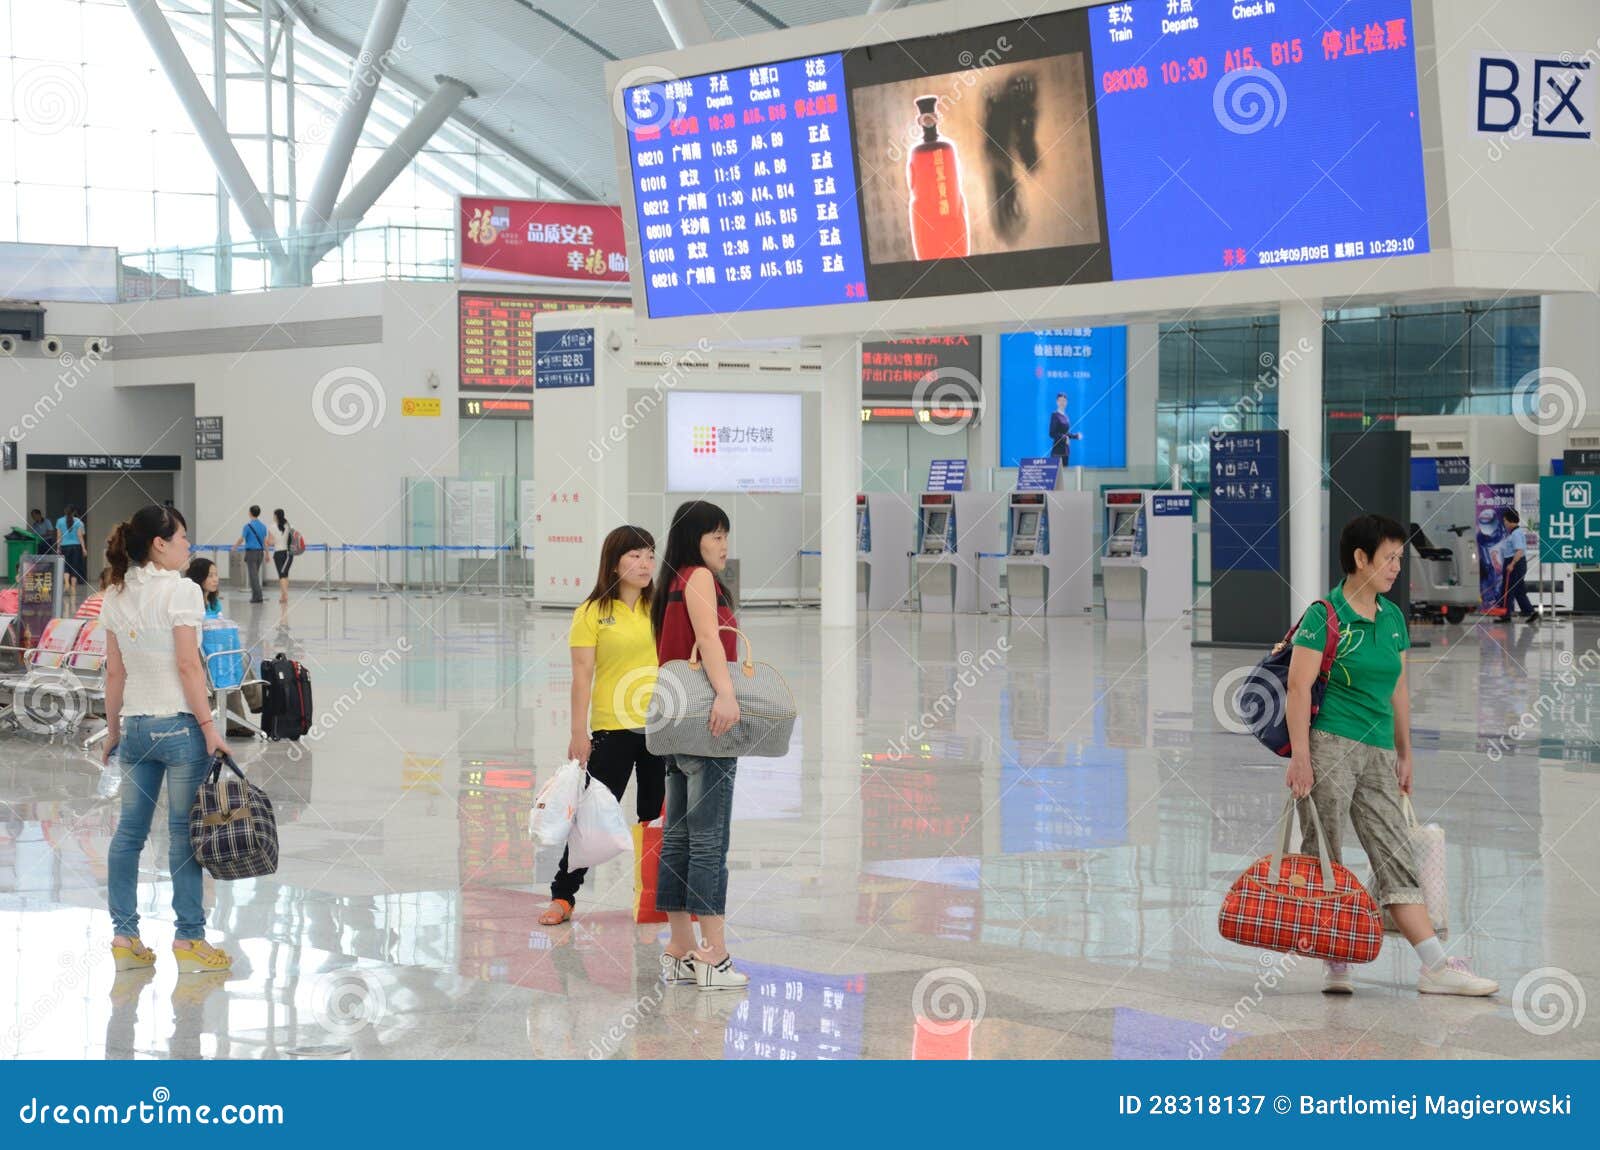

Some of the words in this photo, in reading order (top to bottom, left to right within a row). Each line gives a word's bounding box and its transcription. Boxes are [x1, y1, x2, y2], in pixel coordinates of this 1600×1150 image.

[1108, 4, 1134, 25] 车次
[1232, 5, 1265, 20] Check
[1265, 1, 1276, 14] In
[1109, 28, 1133, 43] Train
[1162, 16, 1199, 35] Departs
[1161, 56, 1208, 85] 10:30
[1322, 18, 1407, 61] 停止检票
[709, 74, 730, 93] 开点
[805, 58, 826, 77] 状态
[1478, 57, 1591, 139] B区
[711, 139, 738, 157] 10:55
[807, 122, 831, 143] 正点
[714, 164, 741, 183] 11:15
[811, 149, 834, 170] 正点
[717, 190, 744, 207] 11:30
[814, 175, 836, 196] 正点
[720, 215, 746, 232] 11:52
[816, 200, 839, 221] 正点
[527, 222, 594, 246] 品质安全
[819, 226, 842, 247] 正点
[566, 247, 629, 275] 幸福临
[1259, 244, 1329, 264] 2012年09月09日
[1369, 237, 1415, 255] 10:29:10
[725, 265, 752, 282] 12:55
[822, 252, 845, 273] 正点
[1549, 511, 1600, 541] 出口
[1561, 544, 1594, 559] Exit
